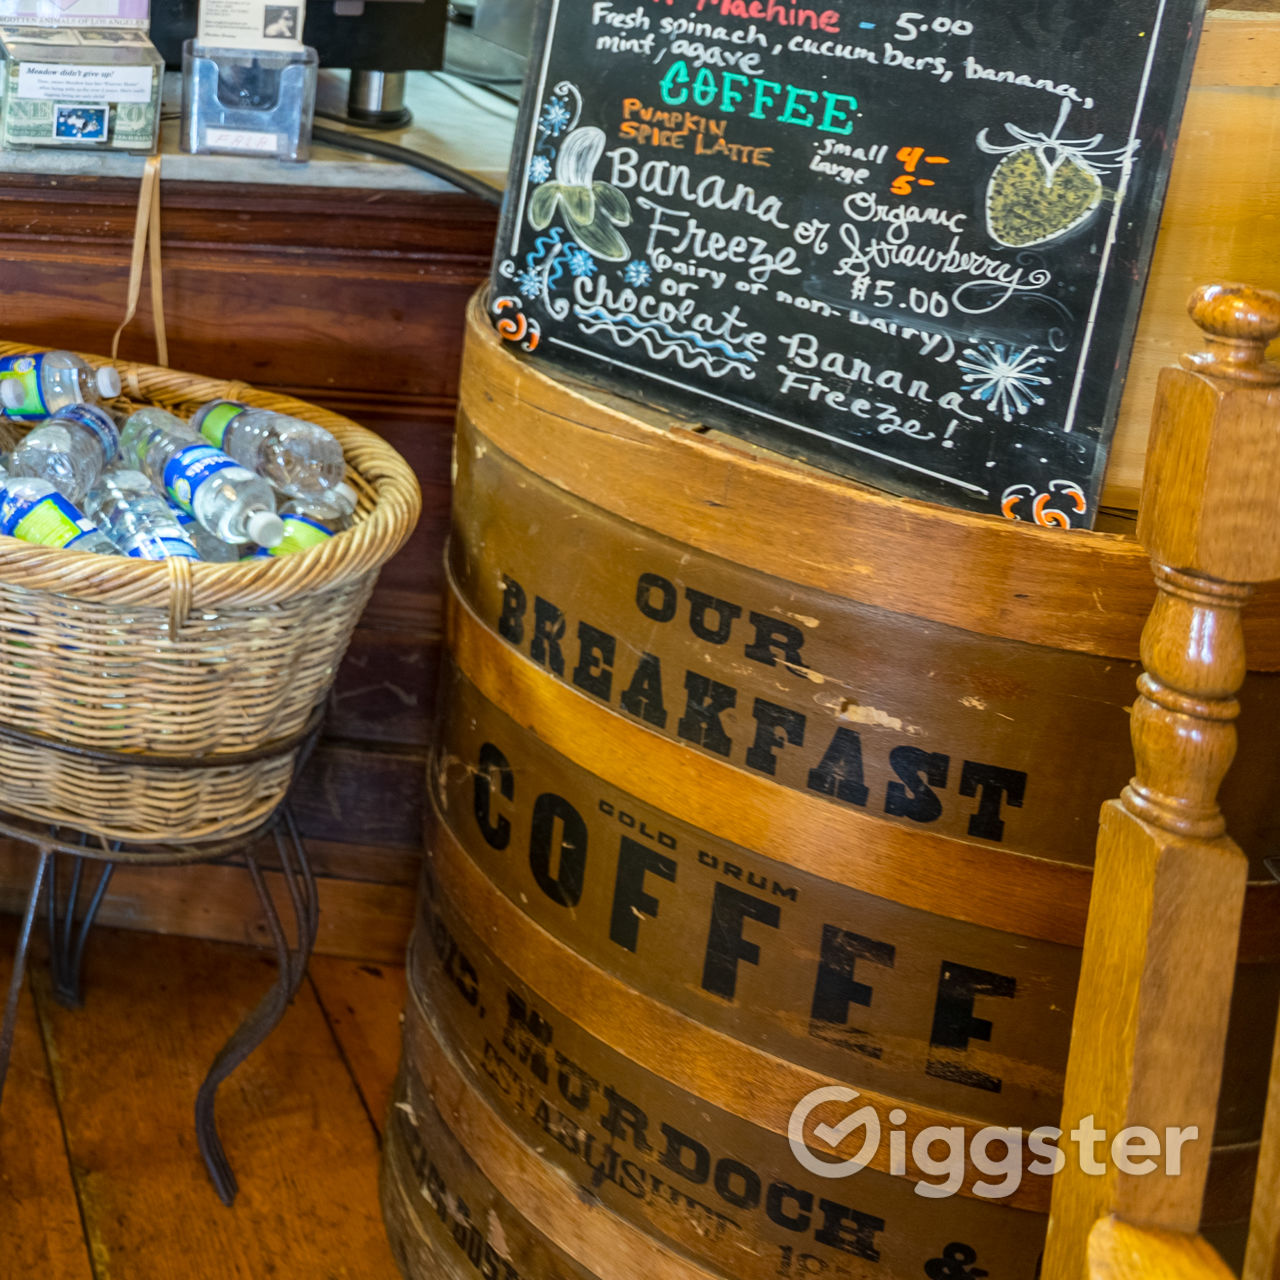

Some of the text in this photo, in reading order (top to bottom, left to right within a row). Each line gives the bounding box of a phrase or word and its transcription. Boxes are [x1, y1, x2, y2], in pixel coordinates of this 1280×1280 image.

[591, 1, 651, 31] Fresh
[894, 11, 974, 42] 5.00
[670, 38, 765, 76] agave
[622, 98, 728, 138] PUMPKIN
[659, 60, 859, 136] COFFEE
[618, 120, 775, 168] SPICE LATTE
[809, 154, 870, 185] Large
[606, 145, 790, 229] Banana
[843, 191, 967, 244] Organic
[636, 196, 1051, 314] Freeze or Strawberry
[661, 277, 700, 298] or
[735, 278, 770, 297] or
[574, 274, 983, 422] Chocolate Banana
[635, 571, 811, 680] OUR
[498, 573, 1028, 842] BREAKFAST
[698, 849, 801, 902] DRUM
[473, 741, 1019, 1093] COFFEE
[503, 988, 886, 1265] MURDOCH
